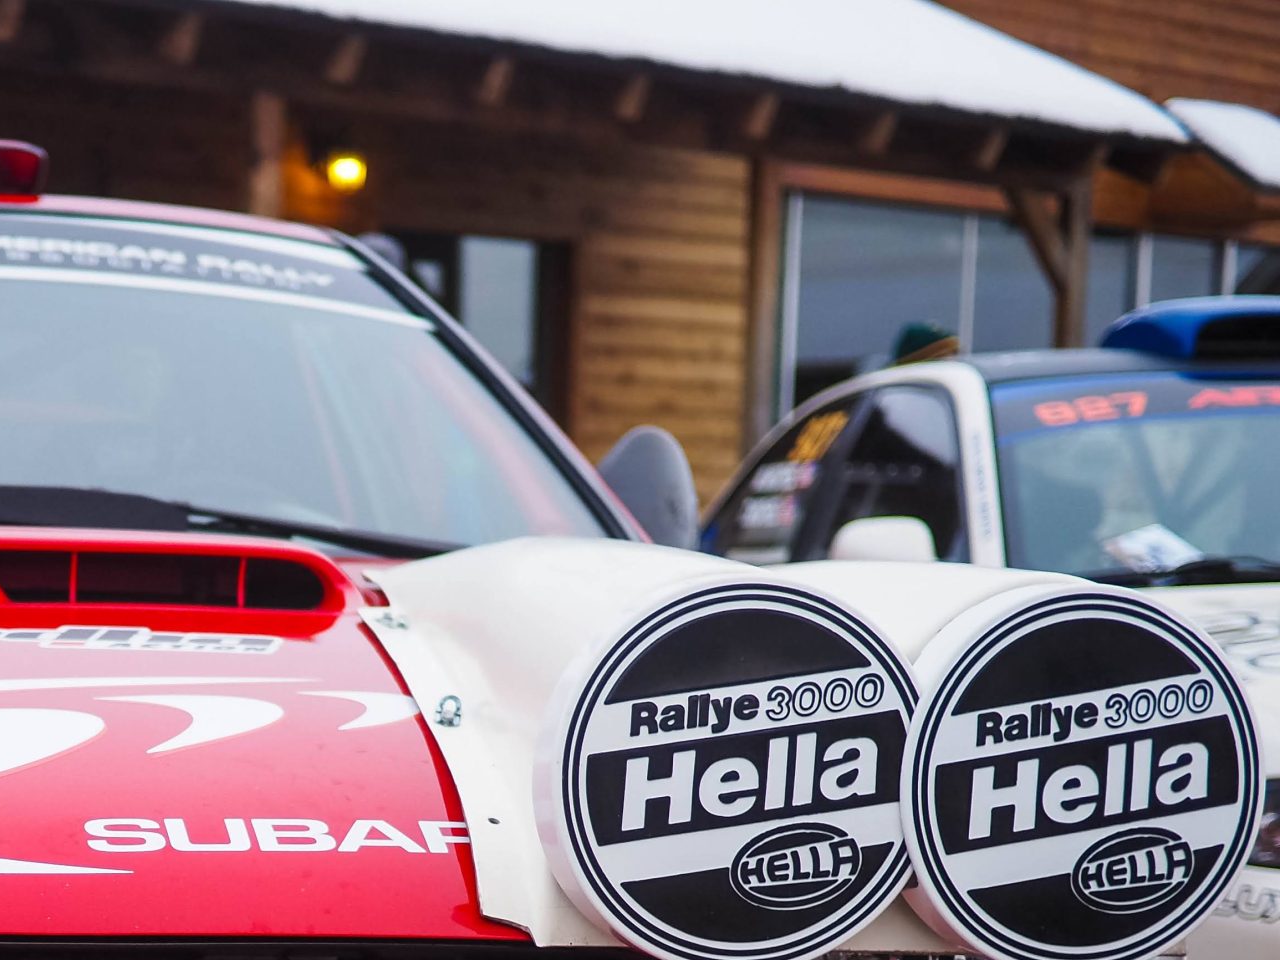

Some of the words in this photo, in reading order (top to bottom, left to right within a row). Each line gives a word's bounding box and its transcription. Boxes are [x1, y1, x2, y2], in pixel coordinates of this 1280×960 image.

[629, 693, 760, 737] Rallye
[766, 673, 886, 721] 3000
[976, 702, 1099, 747] Rallye
[1104, 679, 1214, 729] 3000
[621, 731, 879, 832] Hella
[968, 738, 1210, 841] Hella
[739, 838, 860, 885] HELLA
[1080, 841, 1193, 891] HELLA
